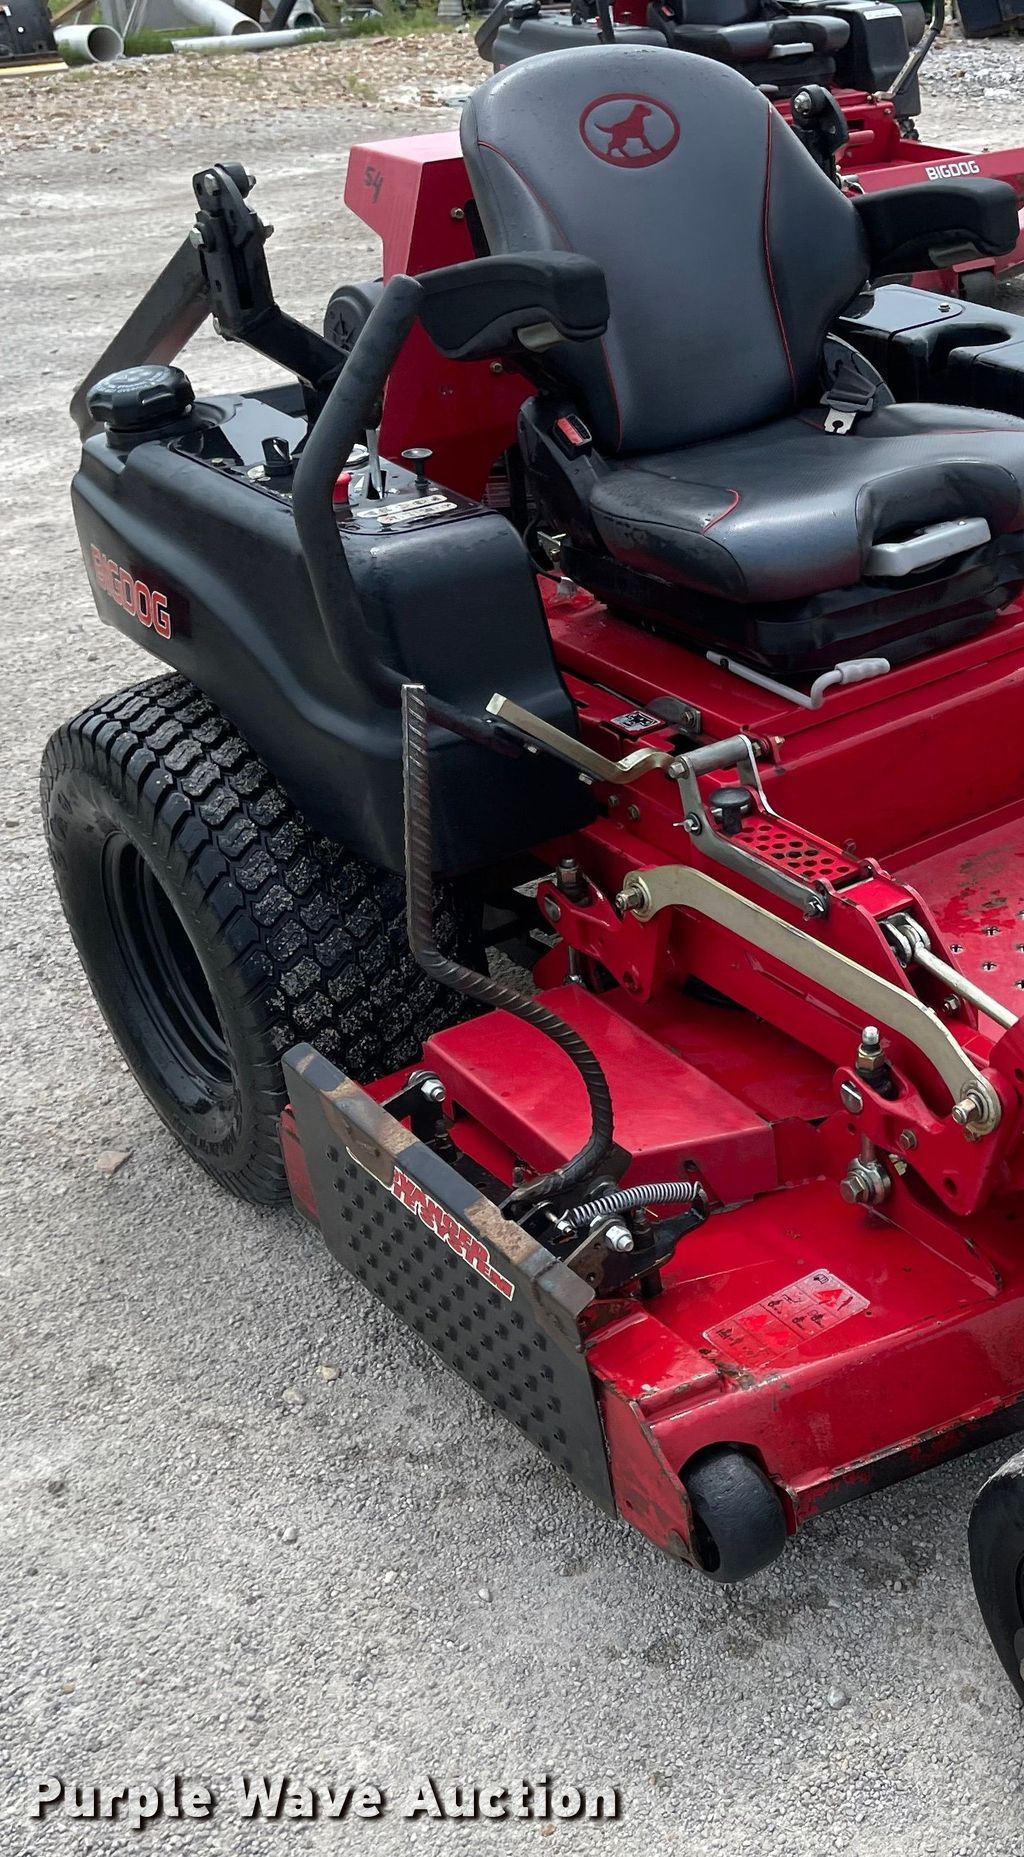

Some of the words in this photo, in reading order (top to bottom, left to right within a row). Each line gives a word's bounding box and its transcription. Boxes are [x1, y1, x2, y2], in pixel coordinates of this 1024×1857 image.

[364, 165, 384, 204] 54
[925, 160, 980, 180] BIGDOG
[90, 543, 171, 639] BIGDOG
